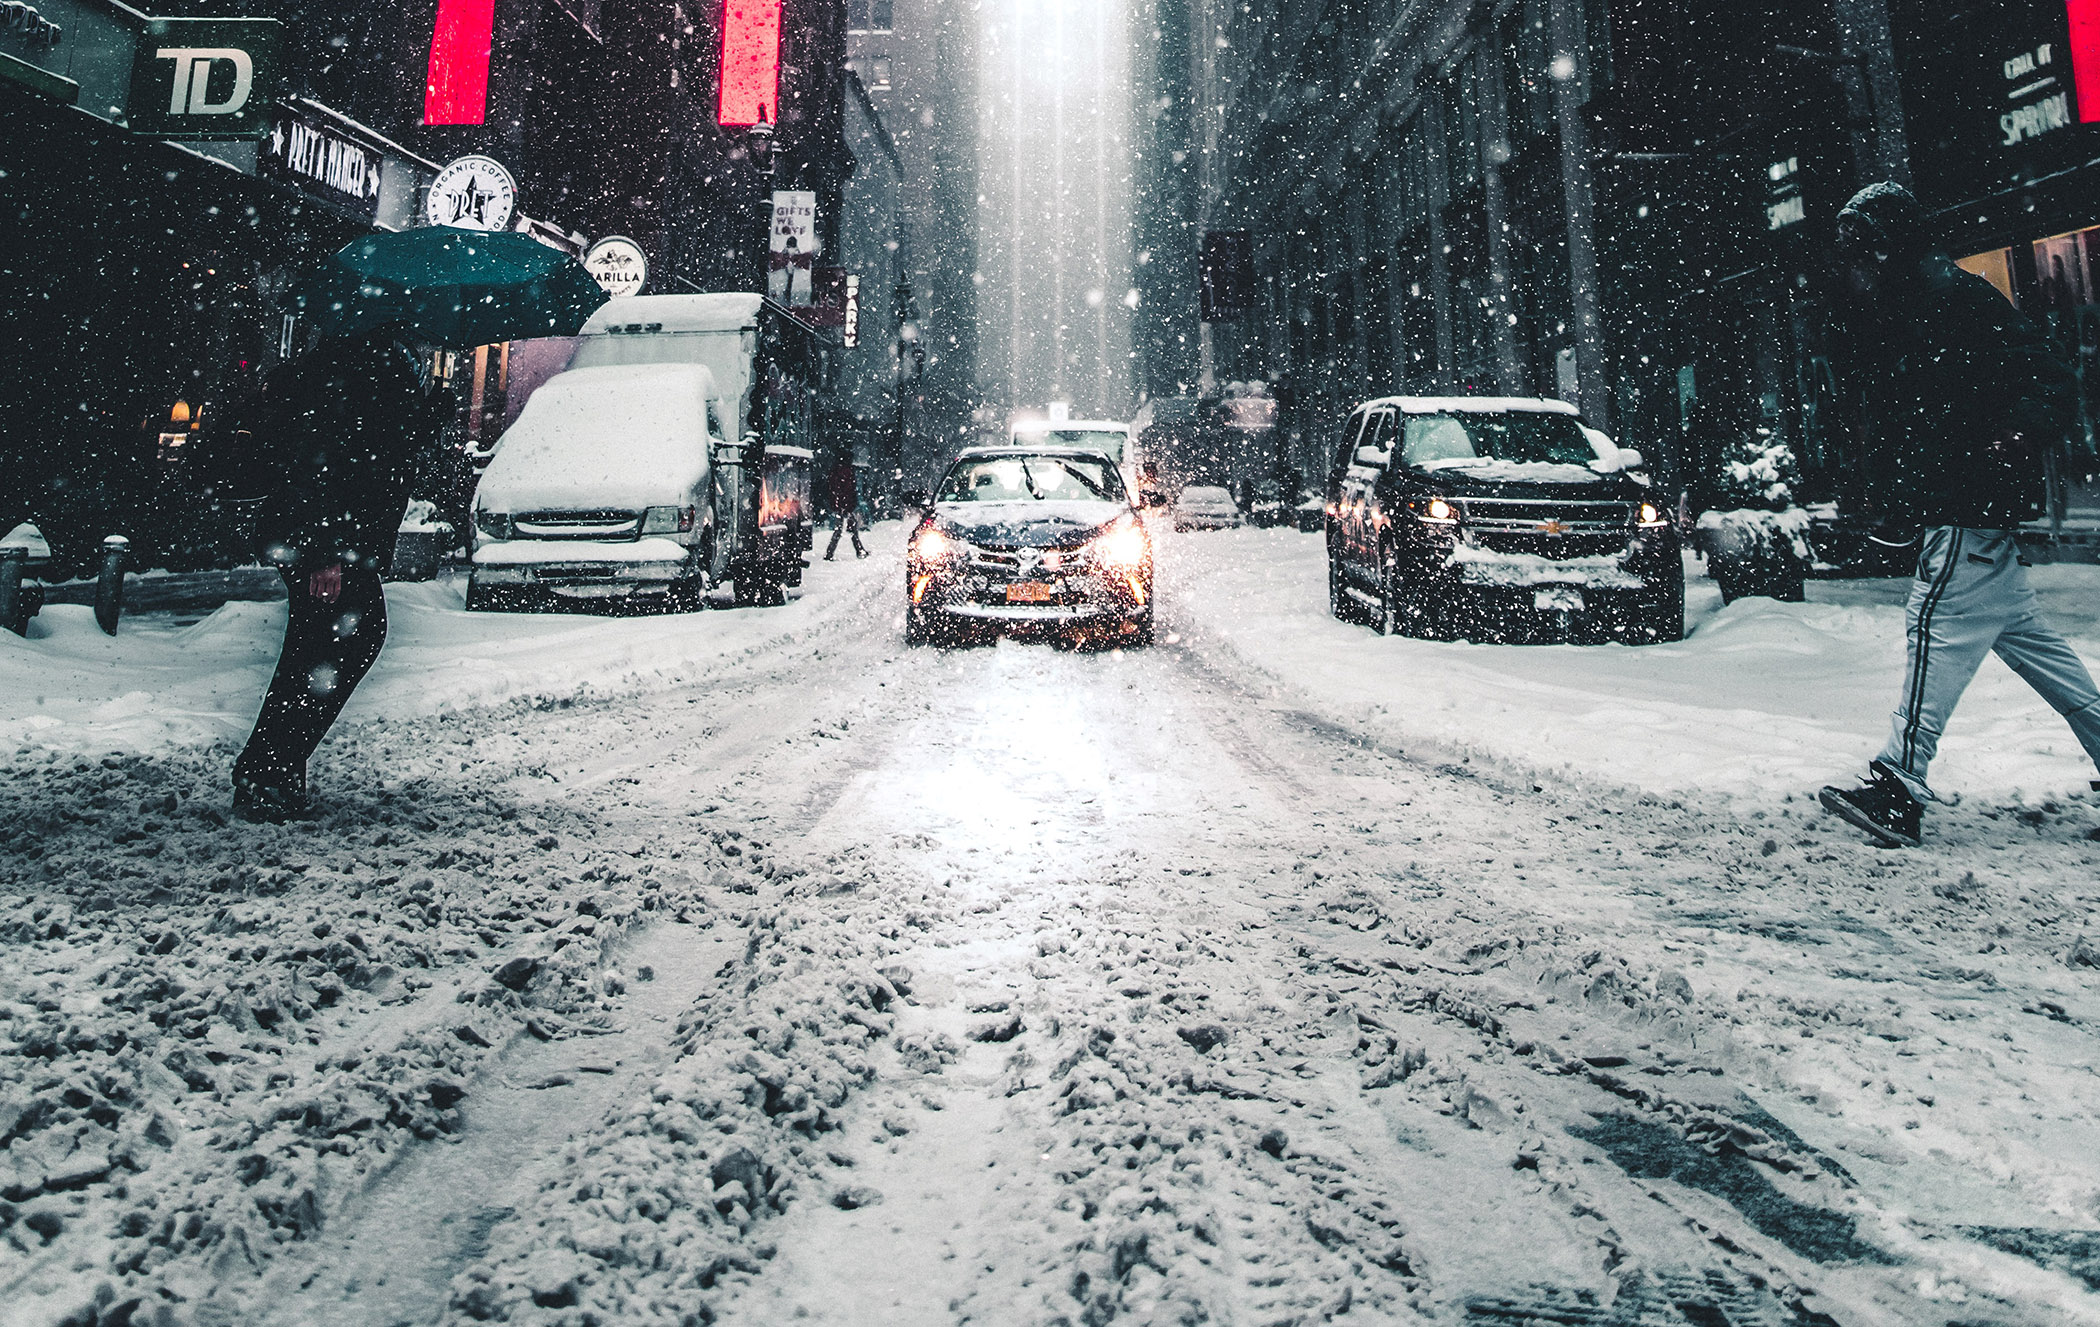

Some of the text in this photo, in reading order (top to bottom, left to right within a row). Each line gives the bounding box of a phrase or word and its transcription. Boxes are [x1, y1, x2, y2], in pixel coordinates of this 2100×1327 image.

[156, 48, 253, 114] TD
[287, 120, 320, 177] PRET
[432, 162, 511, 199] ORGANIC COFFEE
[449, 188, 493, 218] PRET
[776, 206, 811, 216] GIFTS
[776, 216, 794, 226] WE
